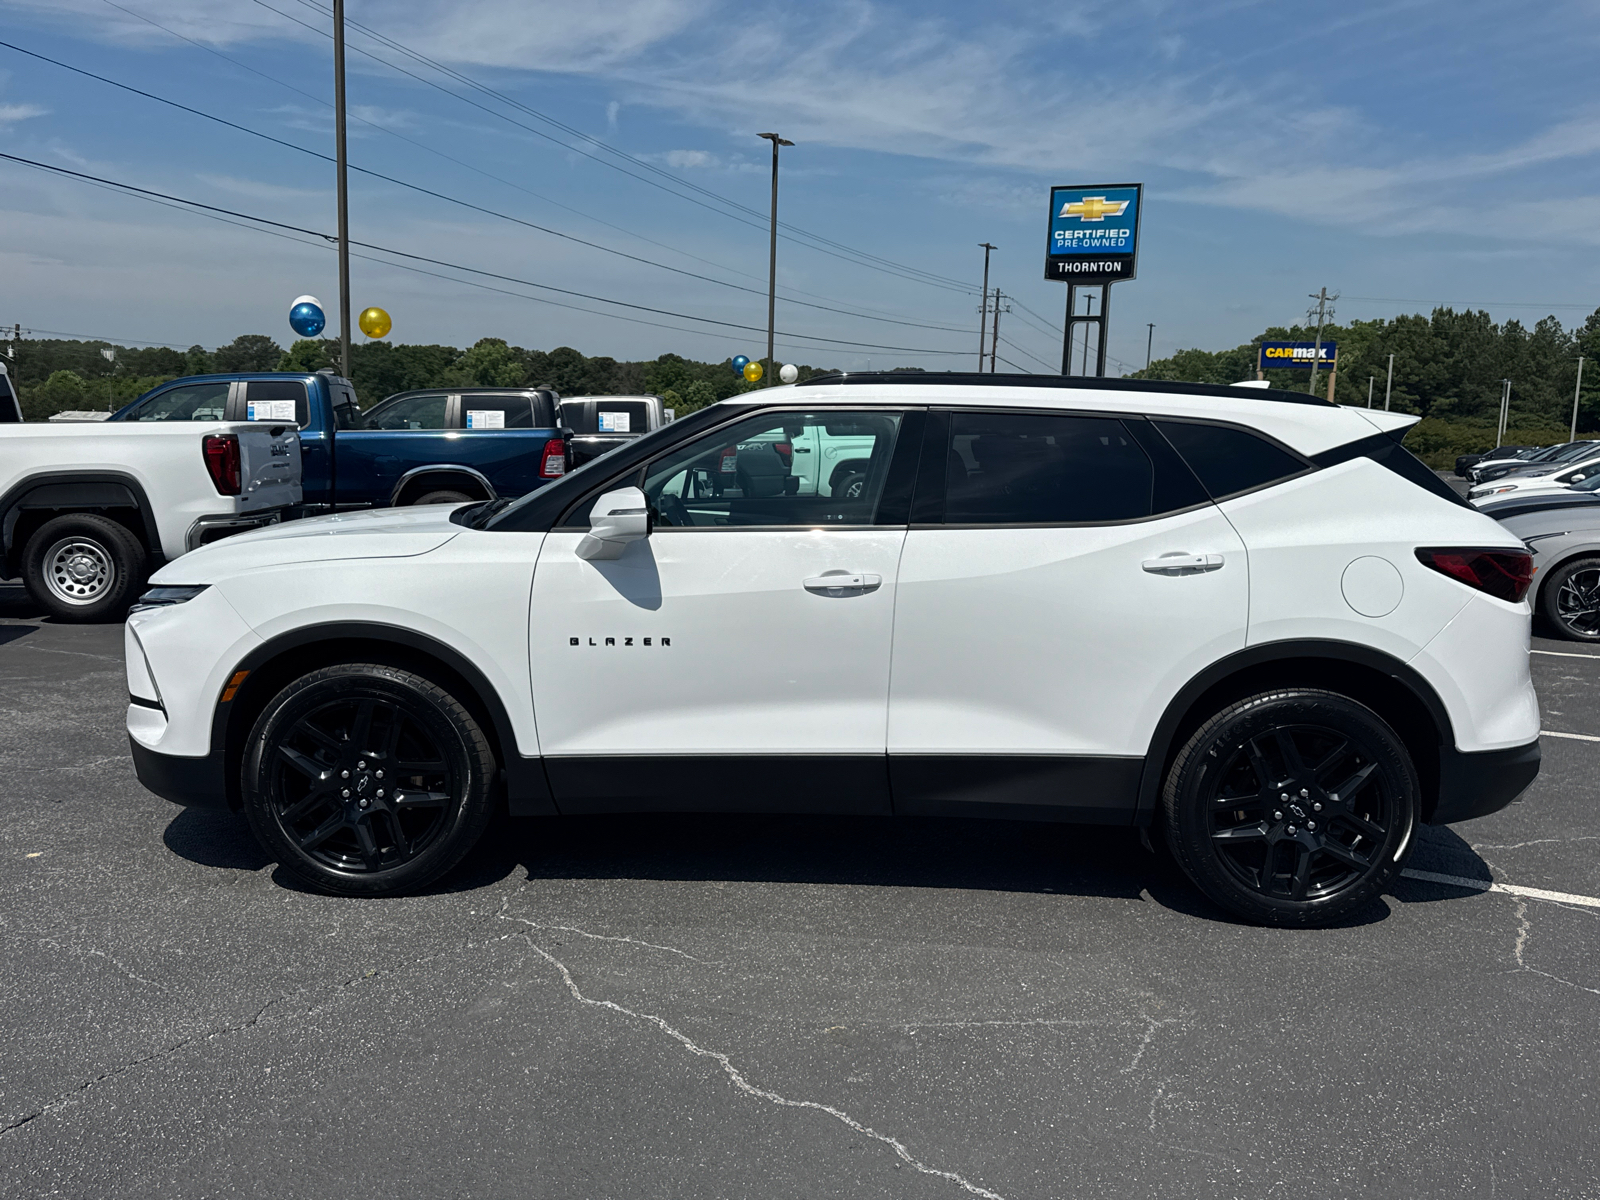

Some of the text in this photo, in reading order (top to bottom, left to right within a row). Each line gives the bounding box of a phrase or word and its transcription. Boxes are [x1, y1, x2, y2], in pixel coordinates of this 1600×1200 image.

[1054, 228, 1130, 239] CERTIFIED
[1057, 238, 1126, 248] PRE-OWNED
[1057, 261, 1122, 273] THORNTON
[569, 637, 671, 646] BLAZER
